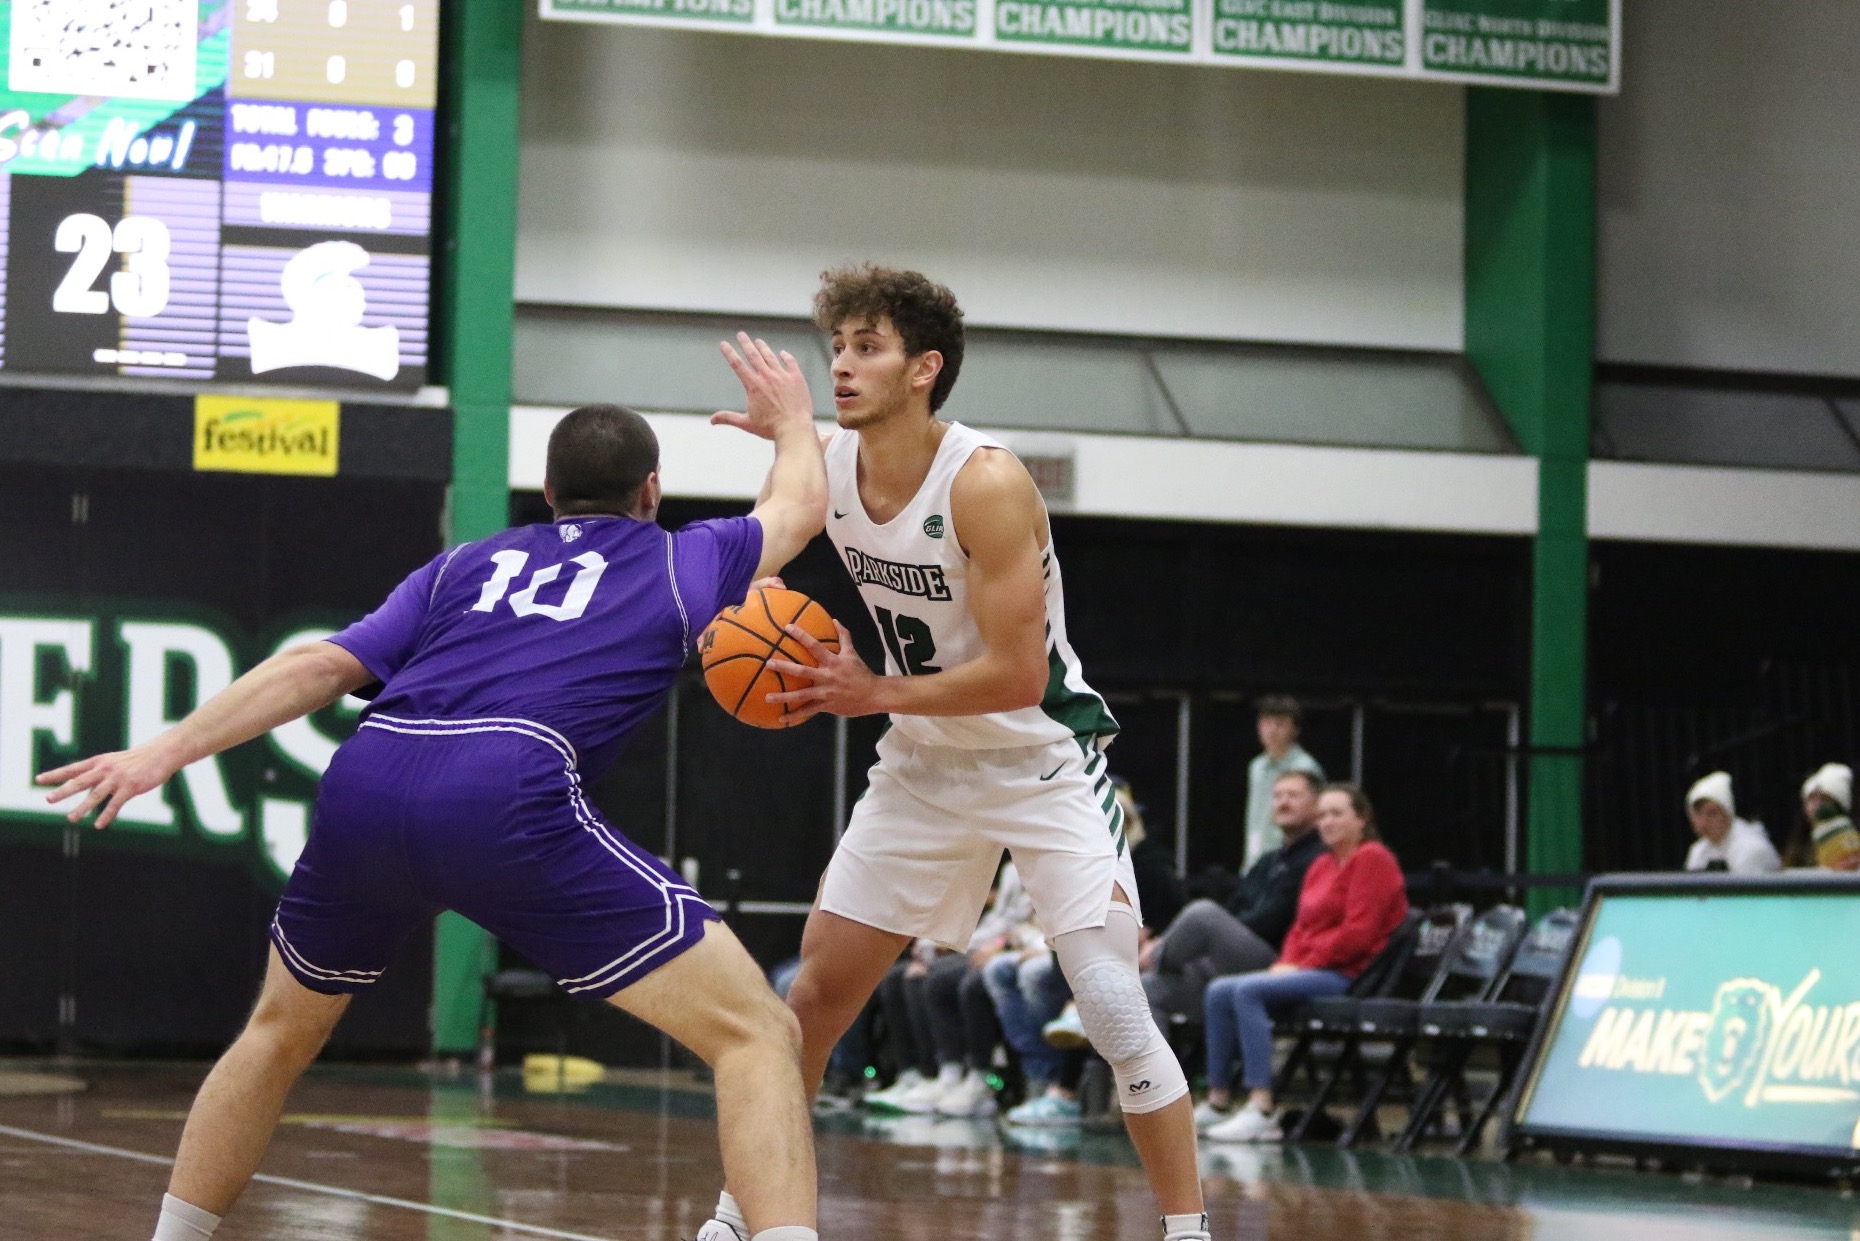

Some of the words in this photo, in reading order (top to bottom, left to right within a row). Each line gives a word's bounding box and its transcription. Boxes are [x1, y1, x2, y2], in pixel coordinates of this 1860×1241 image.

[399, 4, 414, 31] 1
[779, 0, 975, 29] CHAMPIONS
[1000, 3, 1190, 44] CHAMPIONS
[1217, 18, 1402, 60] CHAMPIONS
[1426, 33, 1608, 76] CHAMPIONS
[96, 117, 195, 169] Now!
[53, 213, 171, 317] 23
[204, 418, 328, 457] festival
[464, 549, 608, 621] 10
[845, 547, 952, 601] PARKSIDE
[875, 605, 942, 676] 12
[1578, 1007, 1709, 1074] MAKE
[1744, 968, 1860, 1108] YOUR
